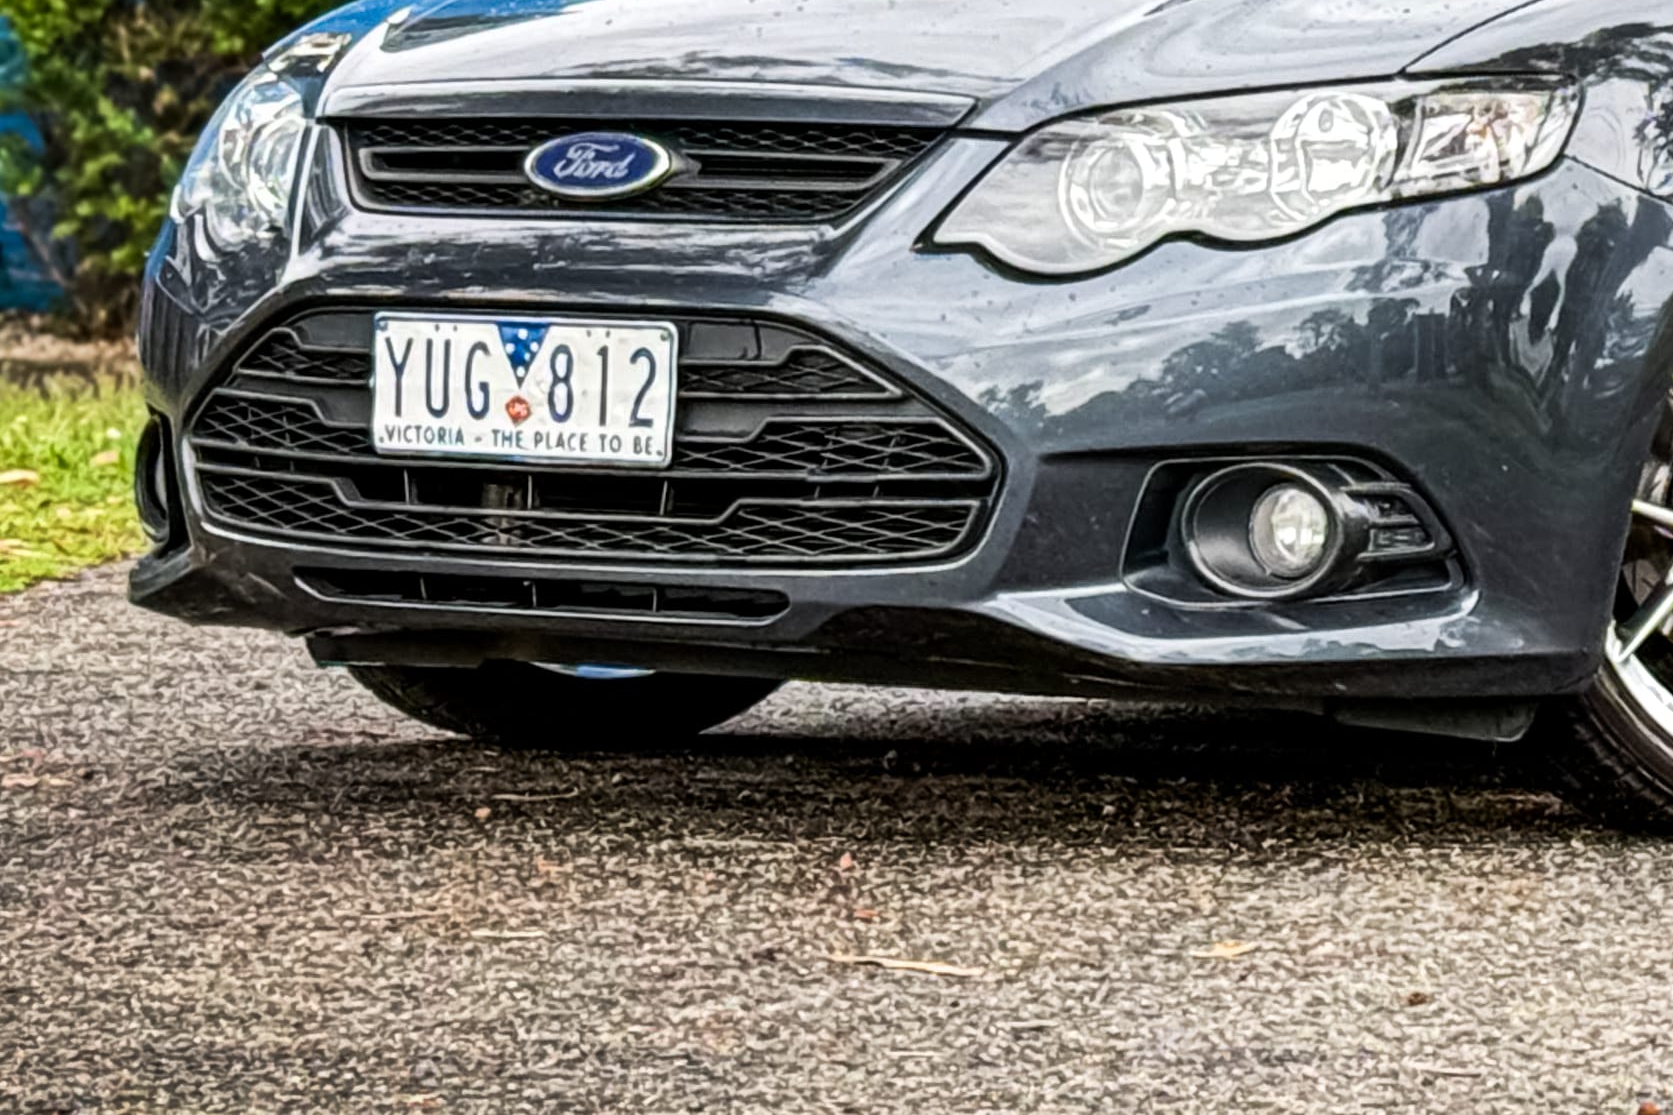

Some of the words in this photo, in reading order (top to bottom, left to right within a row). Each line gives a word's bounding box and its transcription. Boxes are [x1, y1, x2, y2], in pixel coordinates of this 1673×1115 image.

[553, 142, 636, 180] Ford
[385, 336, 491, 421] YUG
[547, 343, 657, 429] 812
[384, 424, 465, 446] VICTORIA
[491, 429, 524, 449] THE
[533, 430, 588, 453] PLACE
[599, 433, 622, 454] TO
